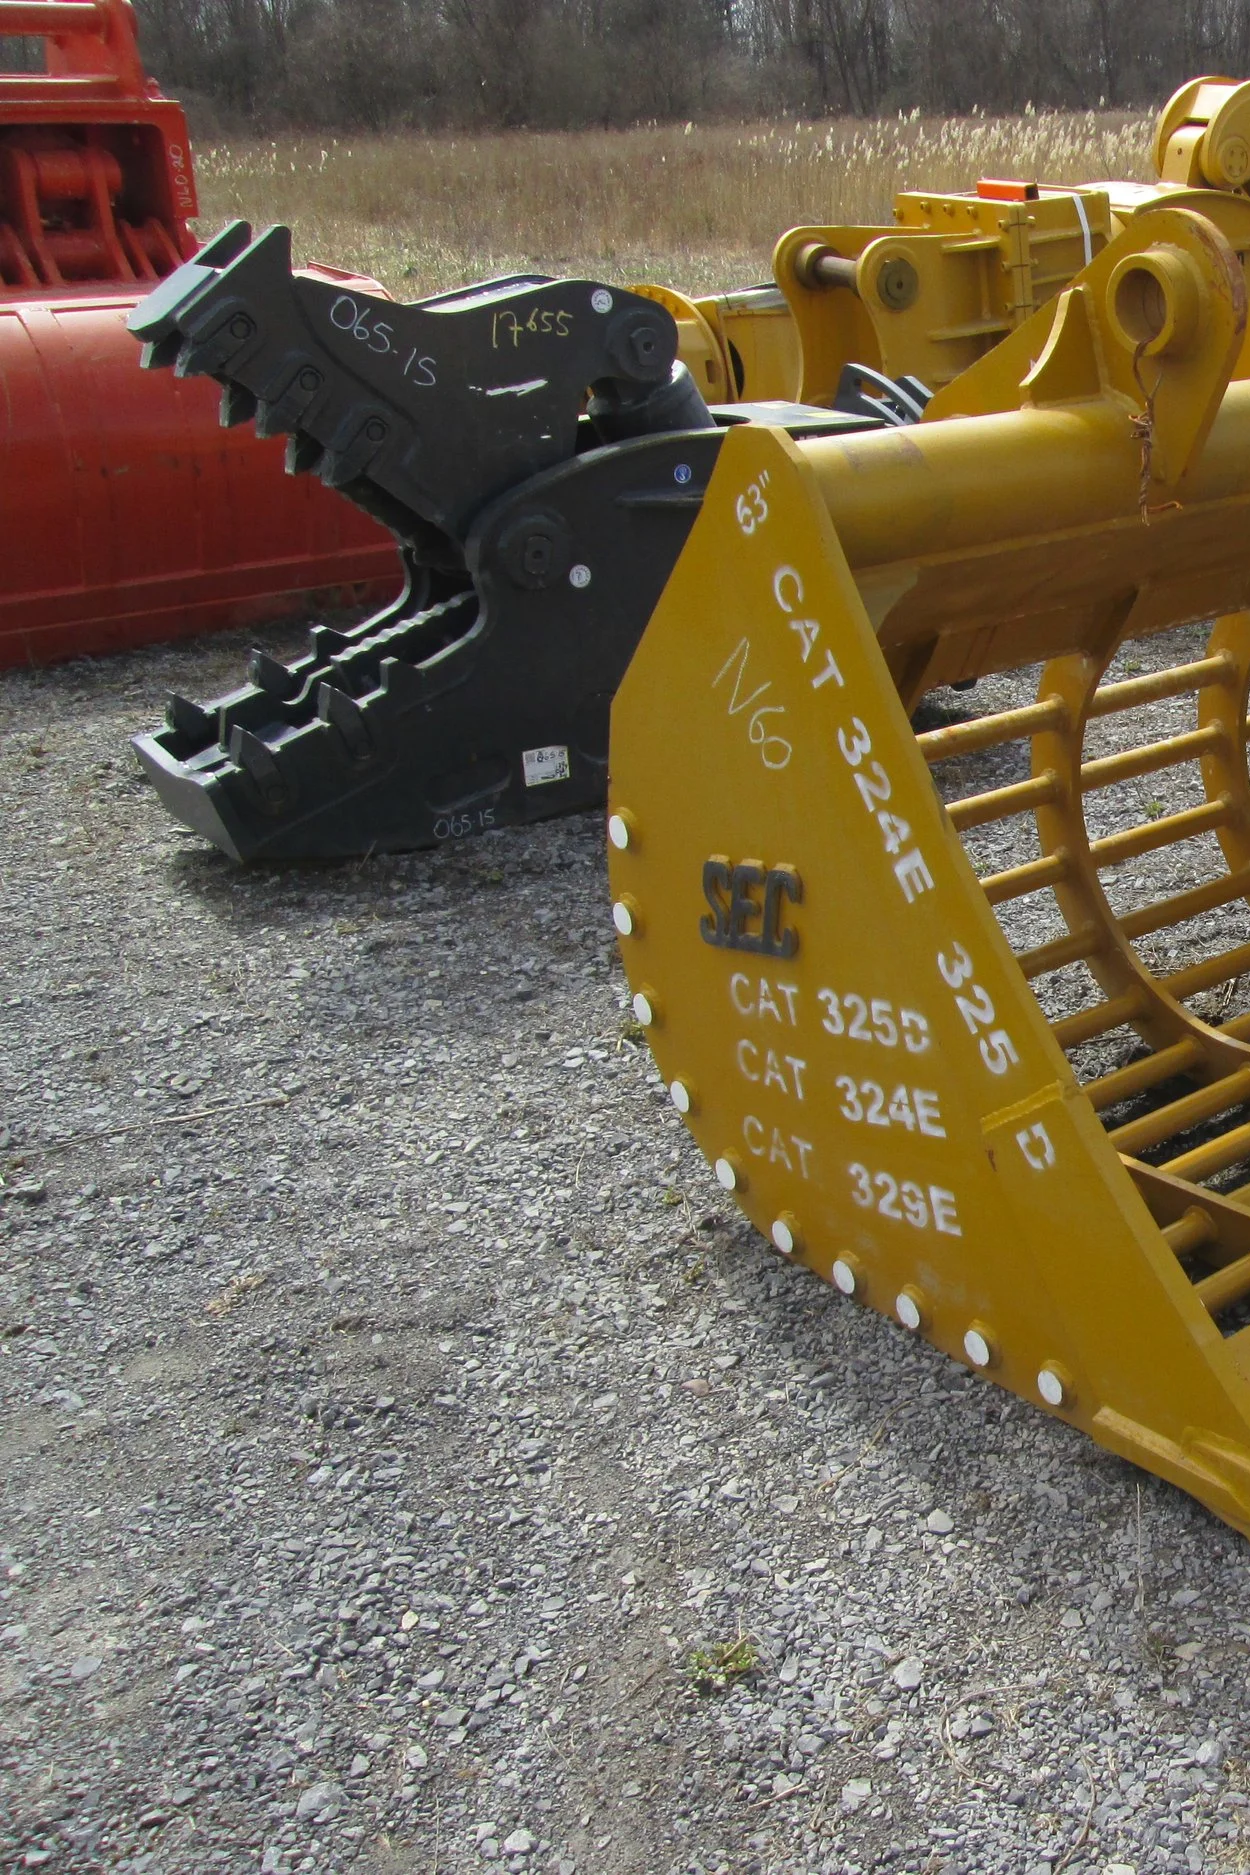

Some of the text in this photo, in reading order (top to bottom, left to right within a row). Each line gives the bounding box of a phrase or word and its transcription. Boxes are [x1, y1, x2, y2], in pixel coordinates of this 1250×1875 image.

[773, 564, 845, 690] CAT
[836, 715, 936, 904] 324E
[936, 940, 1020, 1076] 325
[699, 854, 804, 960] SEC
[730, 972, 932, 1055] CAT 325D
[736, 1039, 947, 1139] CAT 324E
[742, 1114, 963, 1237] CAT 329E
